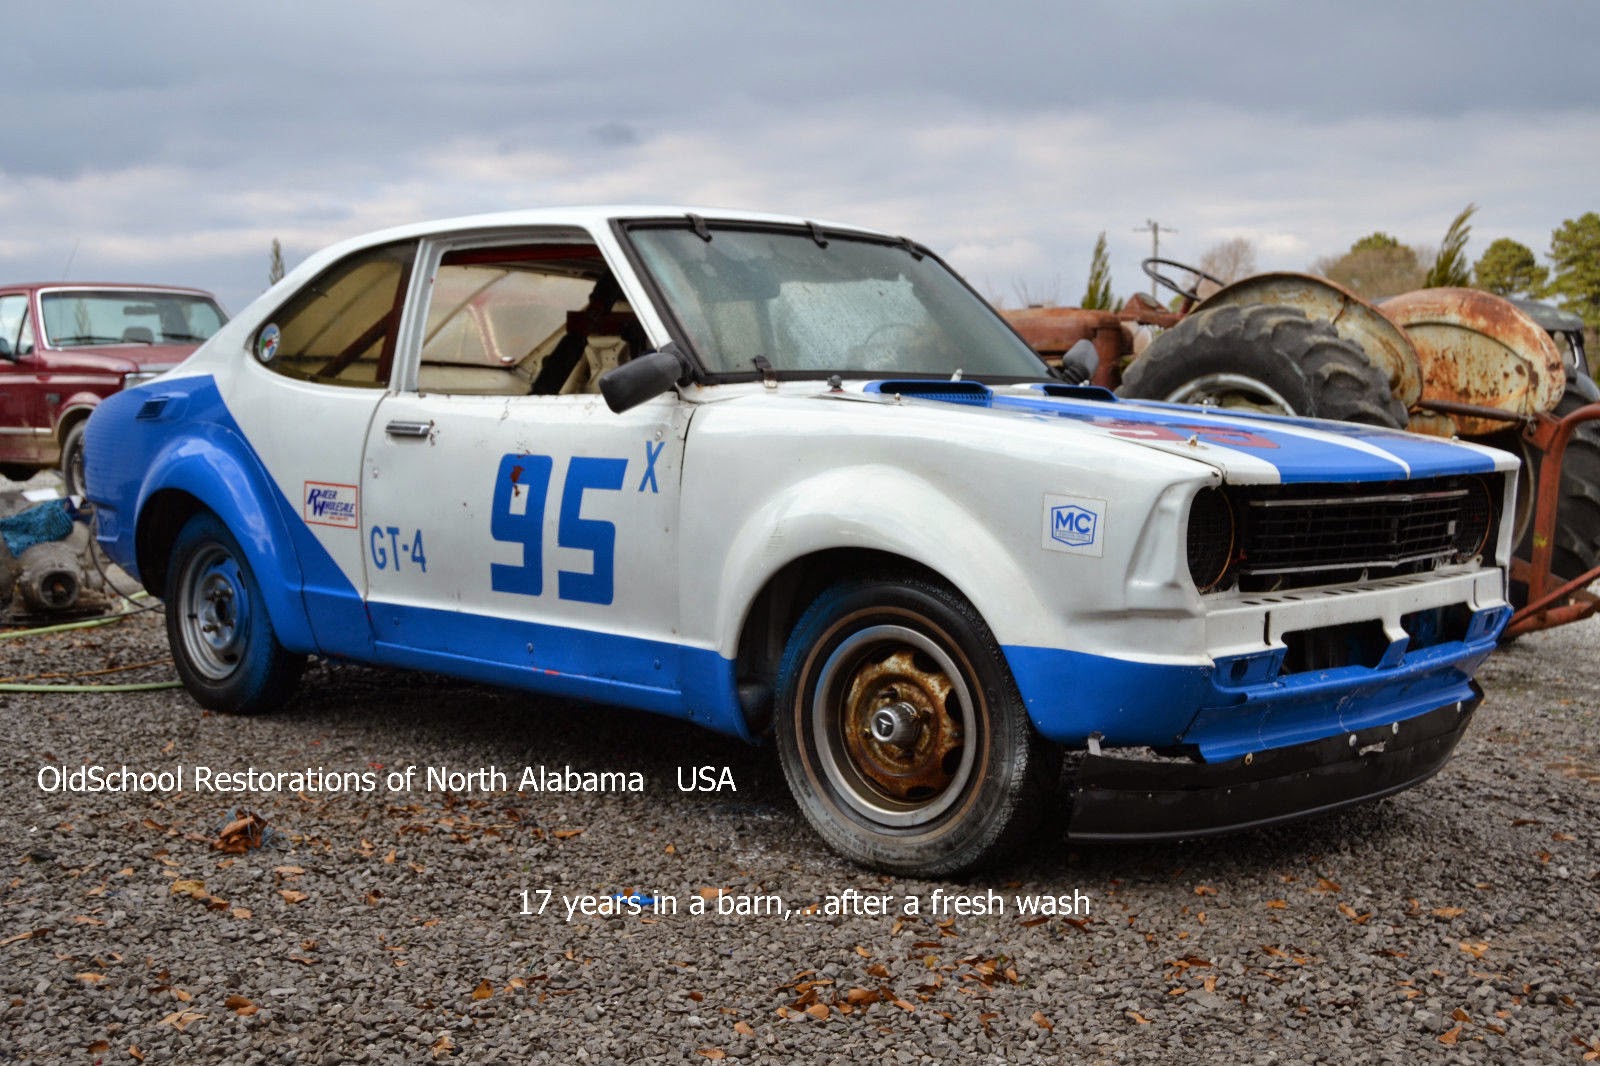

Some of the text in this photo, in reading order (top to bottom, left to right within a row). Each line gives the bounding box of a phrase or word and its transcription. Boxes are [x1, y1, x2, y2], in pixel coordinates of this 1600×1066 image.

[490, 440, 665, 606] 95 X
[1055, 510, 1092, 534] MC
[370, 525, 427, 573] GT-4
